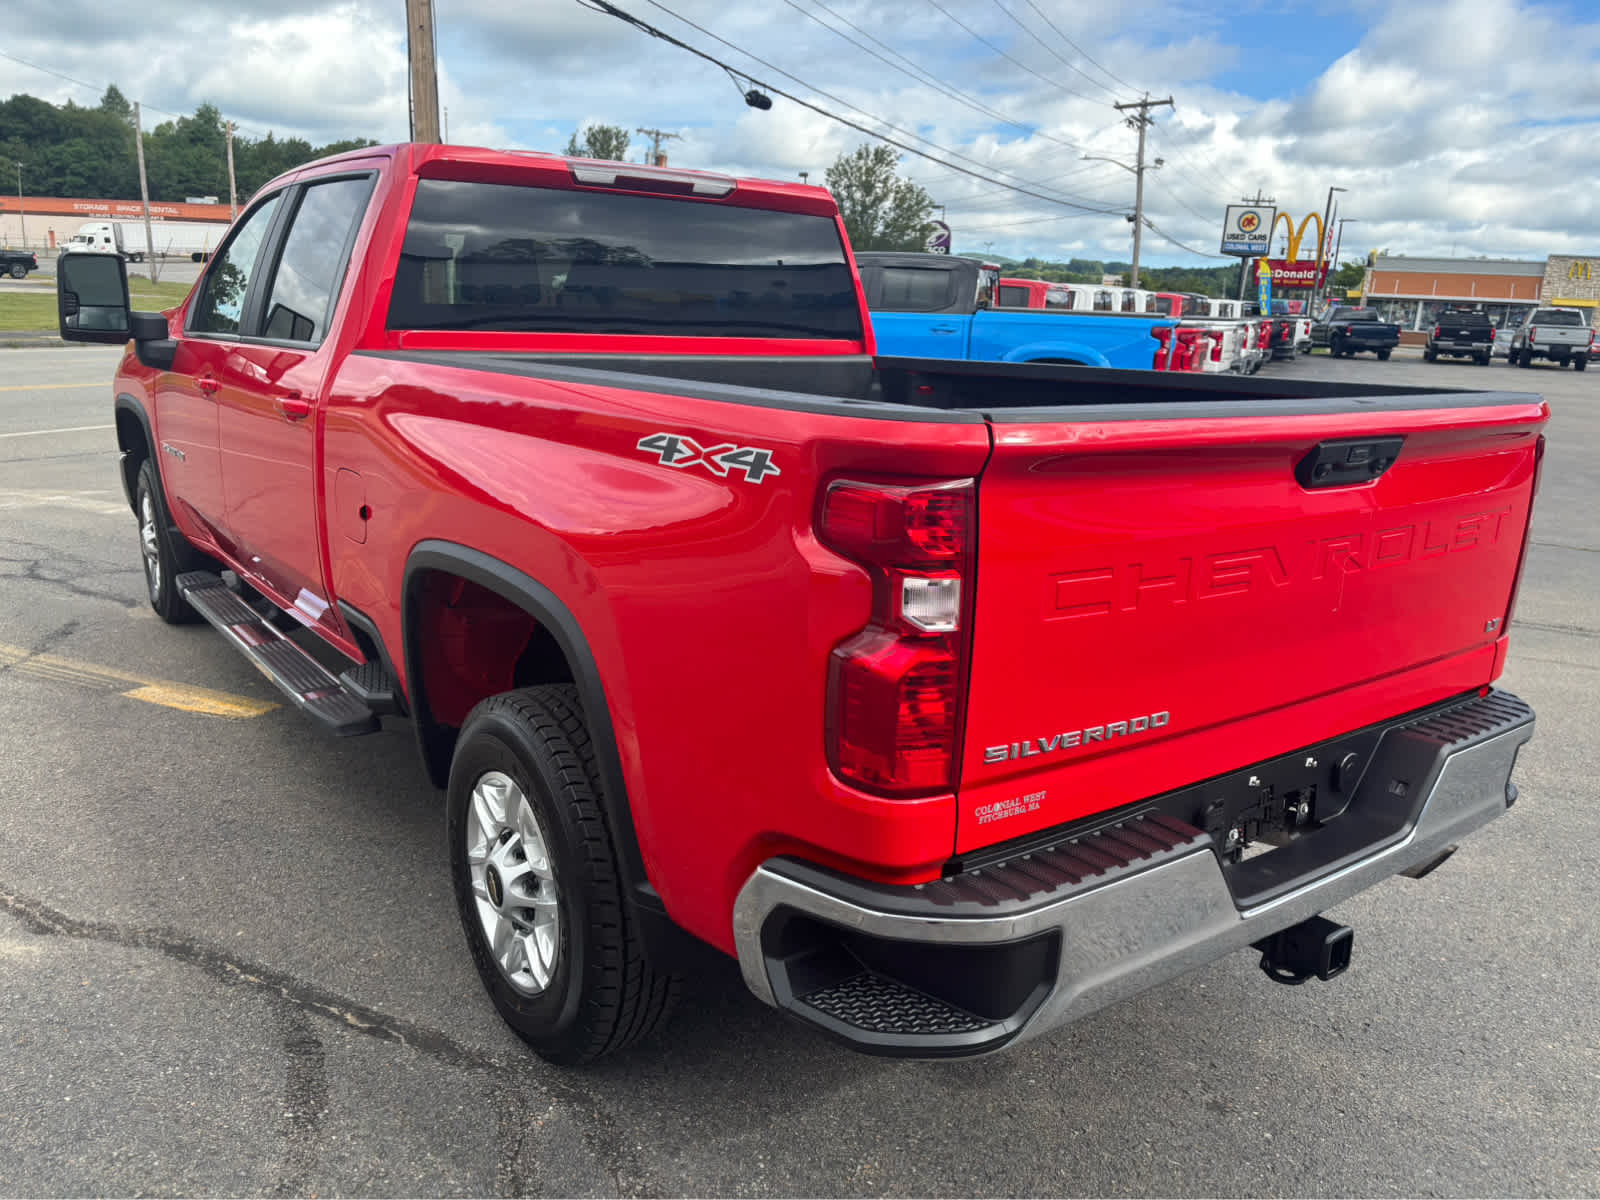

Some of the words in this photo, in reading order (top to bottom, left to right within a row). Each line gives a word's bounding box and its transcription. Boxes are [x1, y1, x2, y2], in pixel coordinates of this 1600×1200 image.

[1226, 233, 1246, 241] USED
[1248, 233, 1267, 241] CARS
[1043, 505, 1512, 621] CHEVROLET
[984, 711, 1170, 764] SILVERADO
[975, 797, 1021, 816] COLONIAL
[1023, 790, 1047, 804] WEST
[1028, 802, 1040, 812] MA
